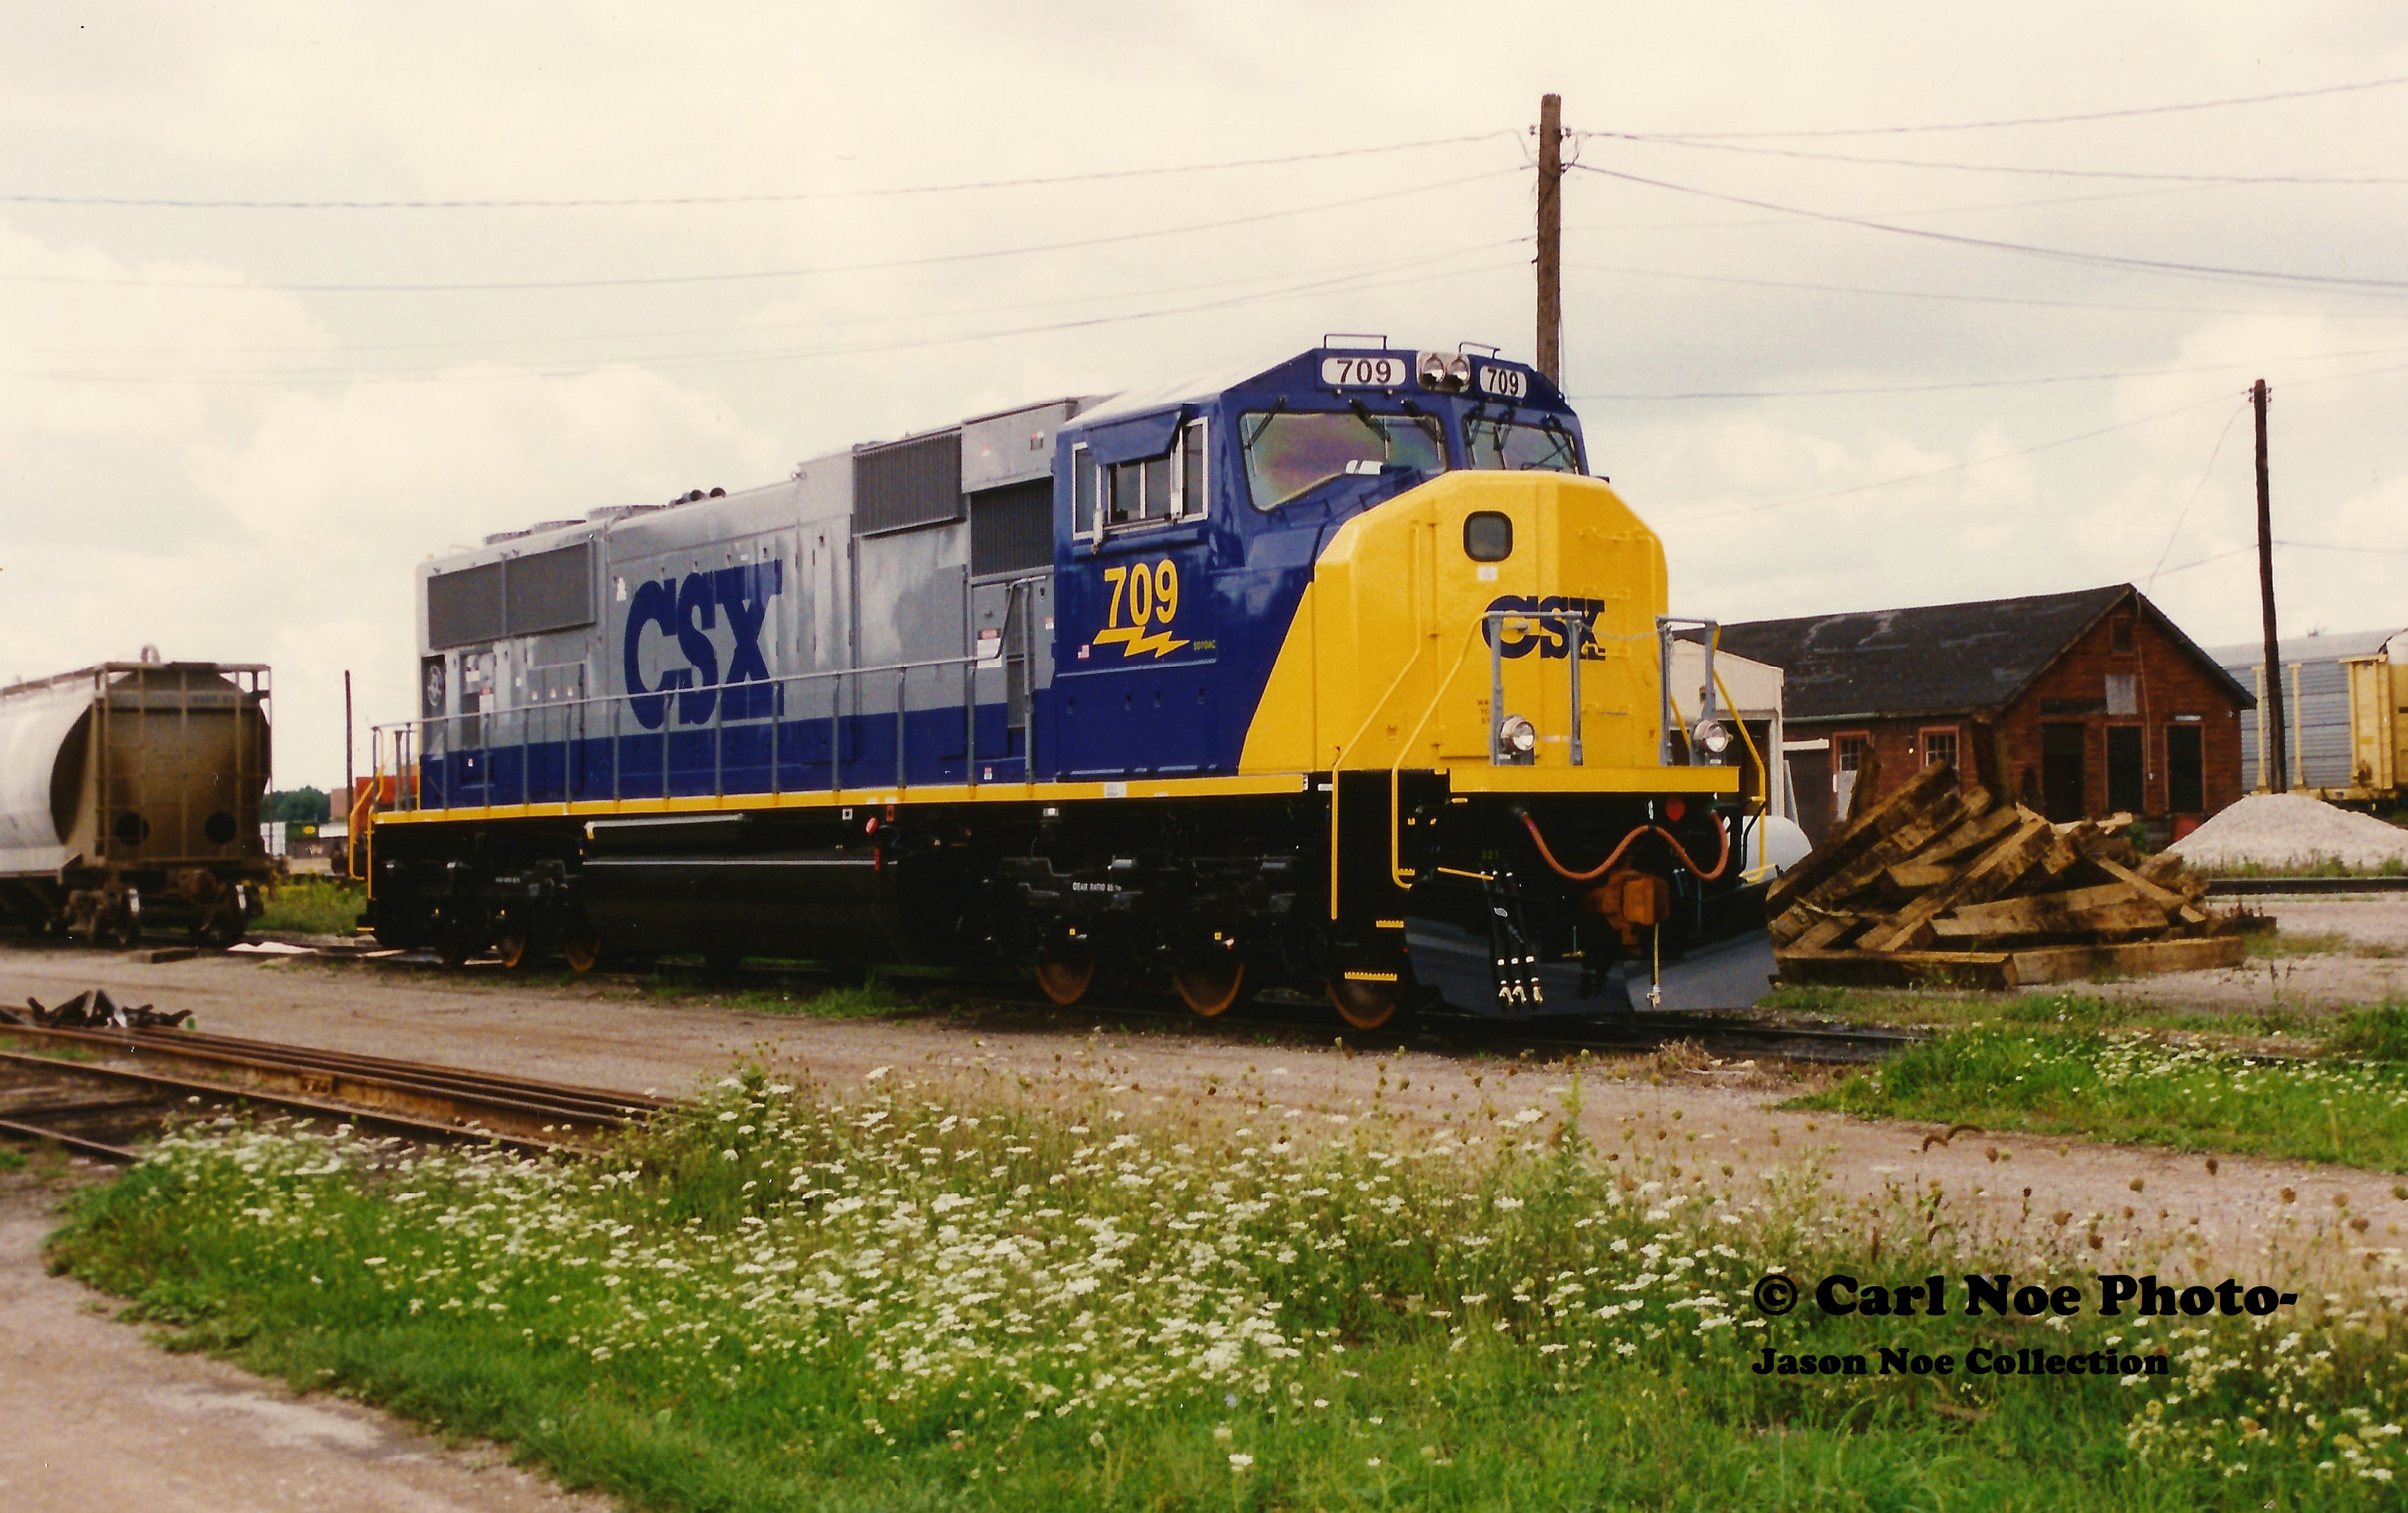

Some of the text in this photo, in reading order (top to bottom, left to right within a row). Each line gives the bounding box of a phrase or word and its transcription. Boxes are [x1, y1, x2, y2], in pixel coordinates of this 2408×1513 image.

[1337, 360, 1392, 384] 709
[1488, 368, 1519, 395] 709
[1104, 558, 1179, 628] 709
[624, 559, 784, 730] CSX
[1482, 595, 1605, 660] CSX
[1072, 881, 1088, 891] GEAR
[1090, 883, 1106, 891] RATIO
